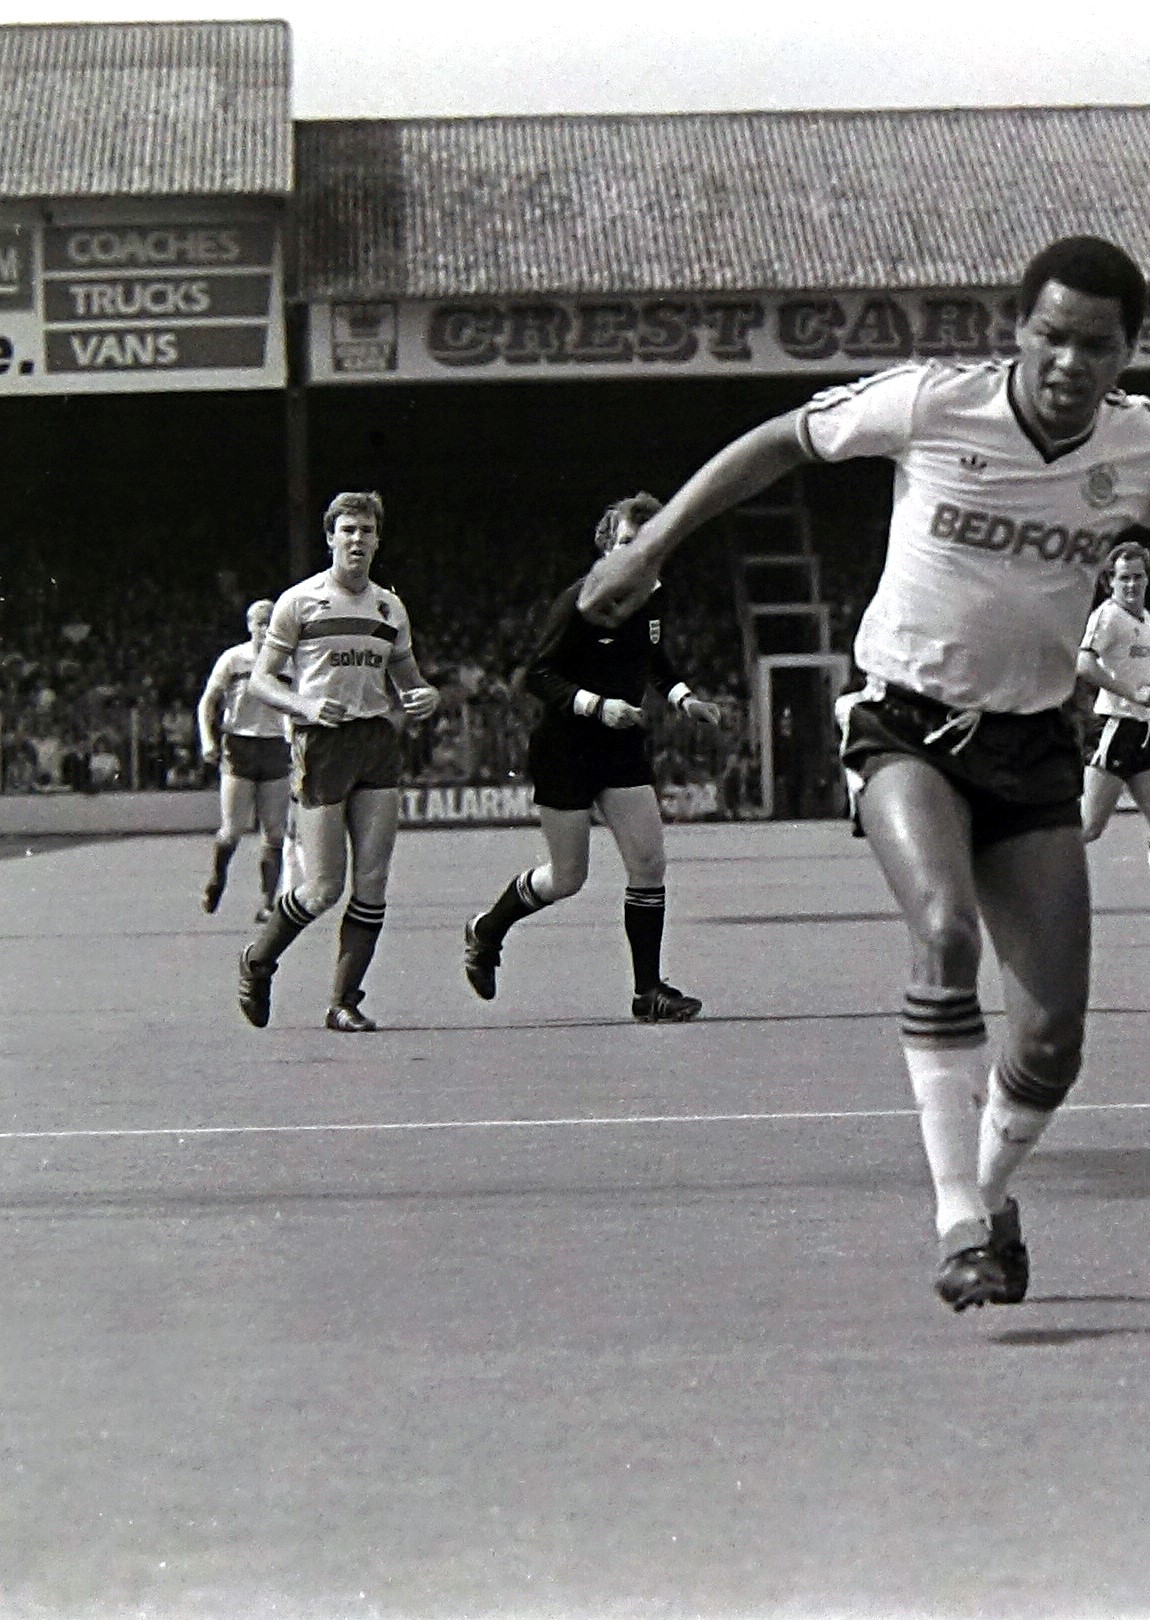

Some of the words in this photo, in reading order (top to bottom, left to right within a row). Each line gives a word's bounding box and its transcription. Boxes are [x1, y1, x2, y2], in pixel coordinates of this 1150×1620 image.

[67, 231, 240, 263] COACHES
[69, 281, 211, 316] TRUCKS
[70, 333, 178, 366] VANS
[328, 648, 384, 668] solvite
